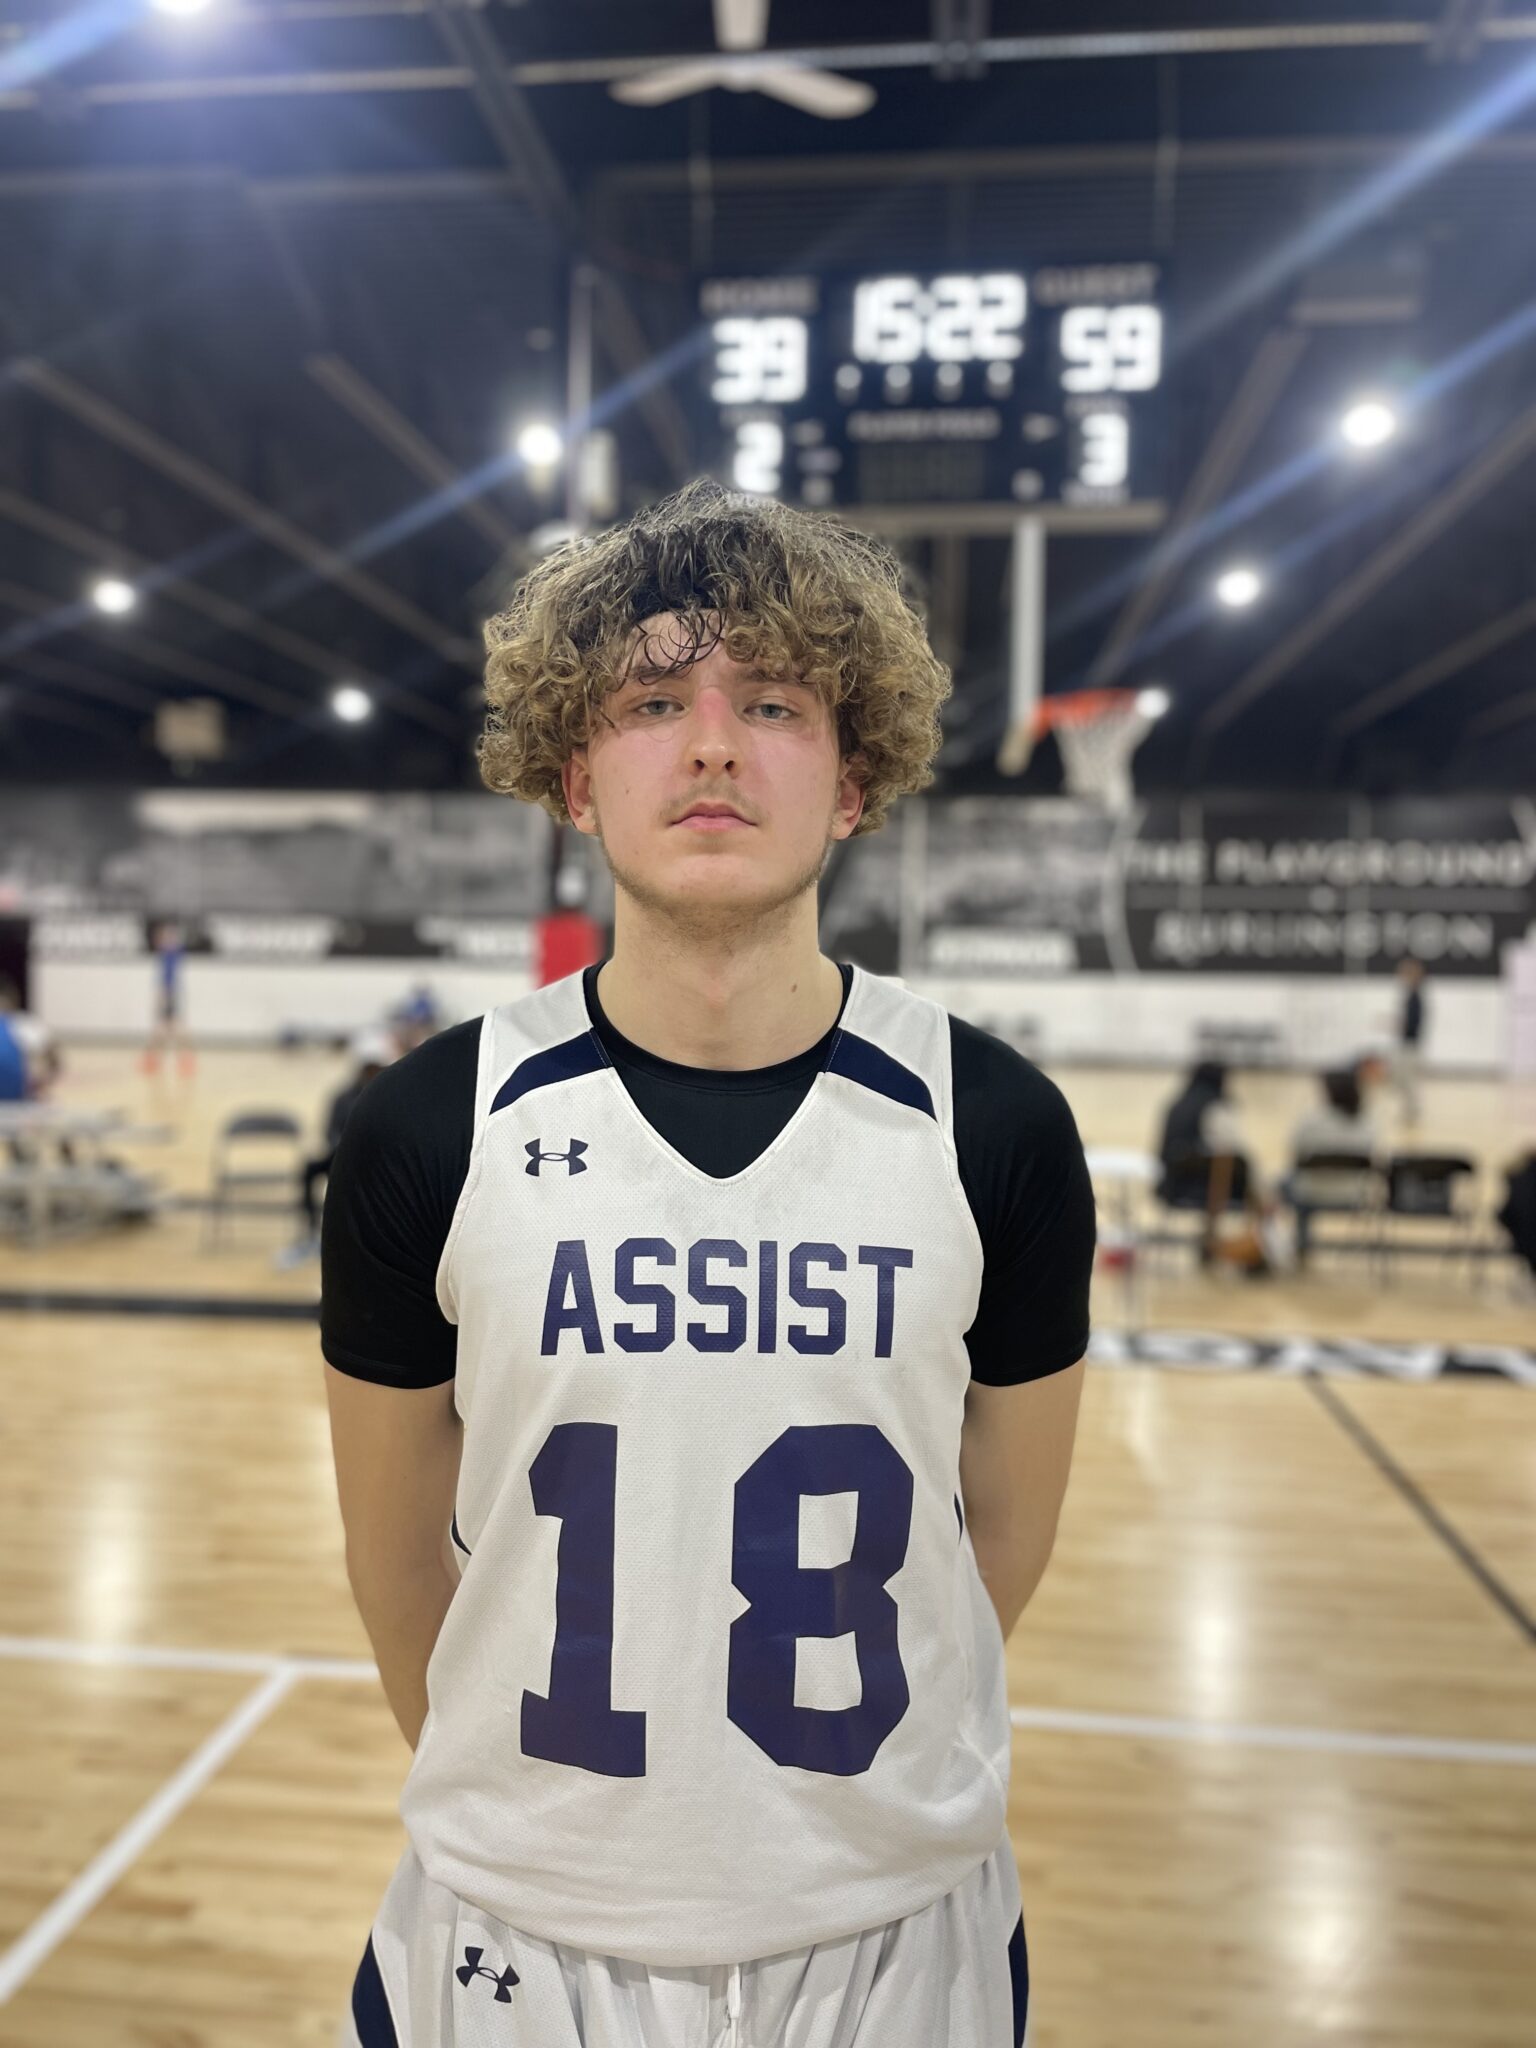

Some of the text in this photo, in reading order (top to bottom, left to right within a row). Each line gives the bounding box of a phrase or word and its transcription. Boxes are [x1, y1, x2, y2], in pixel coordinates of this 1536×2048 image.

[711, 317, 808, 403] 39
[1060, 305, 1163, 393] 59
[733, 421, 784, 494] 2
[1079, 412, 1129, 487] 3
[541, 1238, 914, 1358] ASSIST
[521, 1422, 915, 1777] 18
